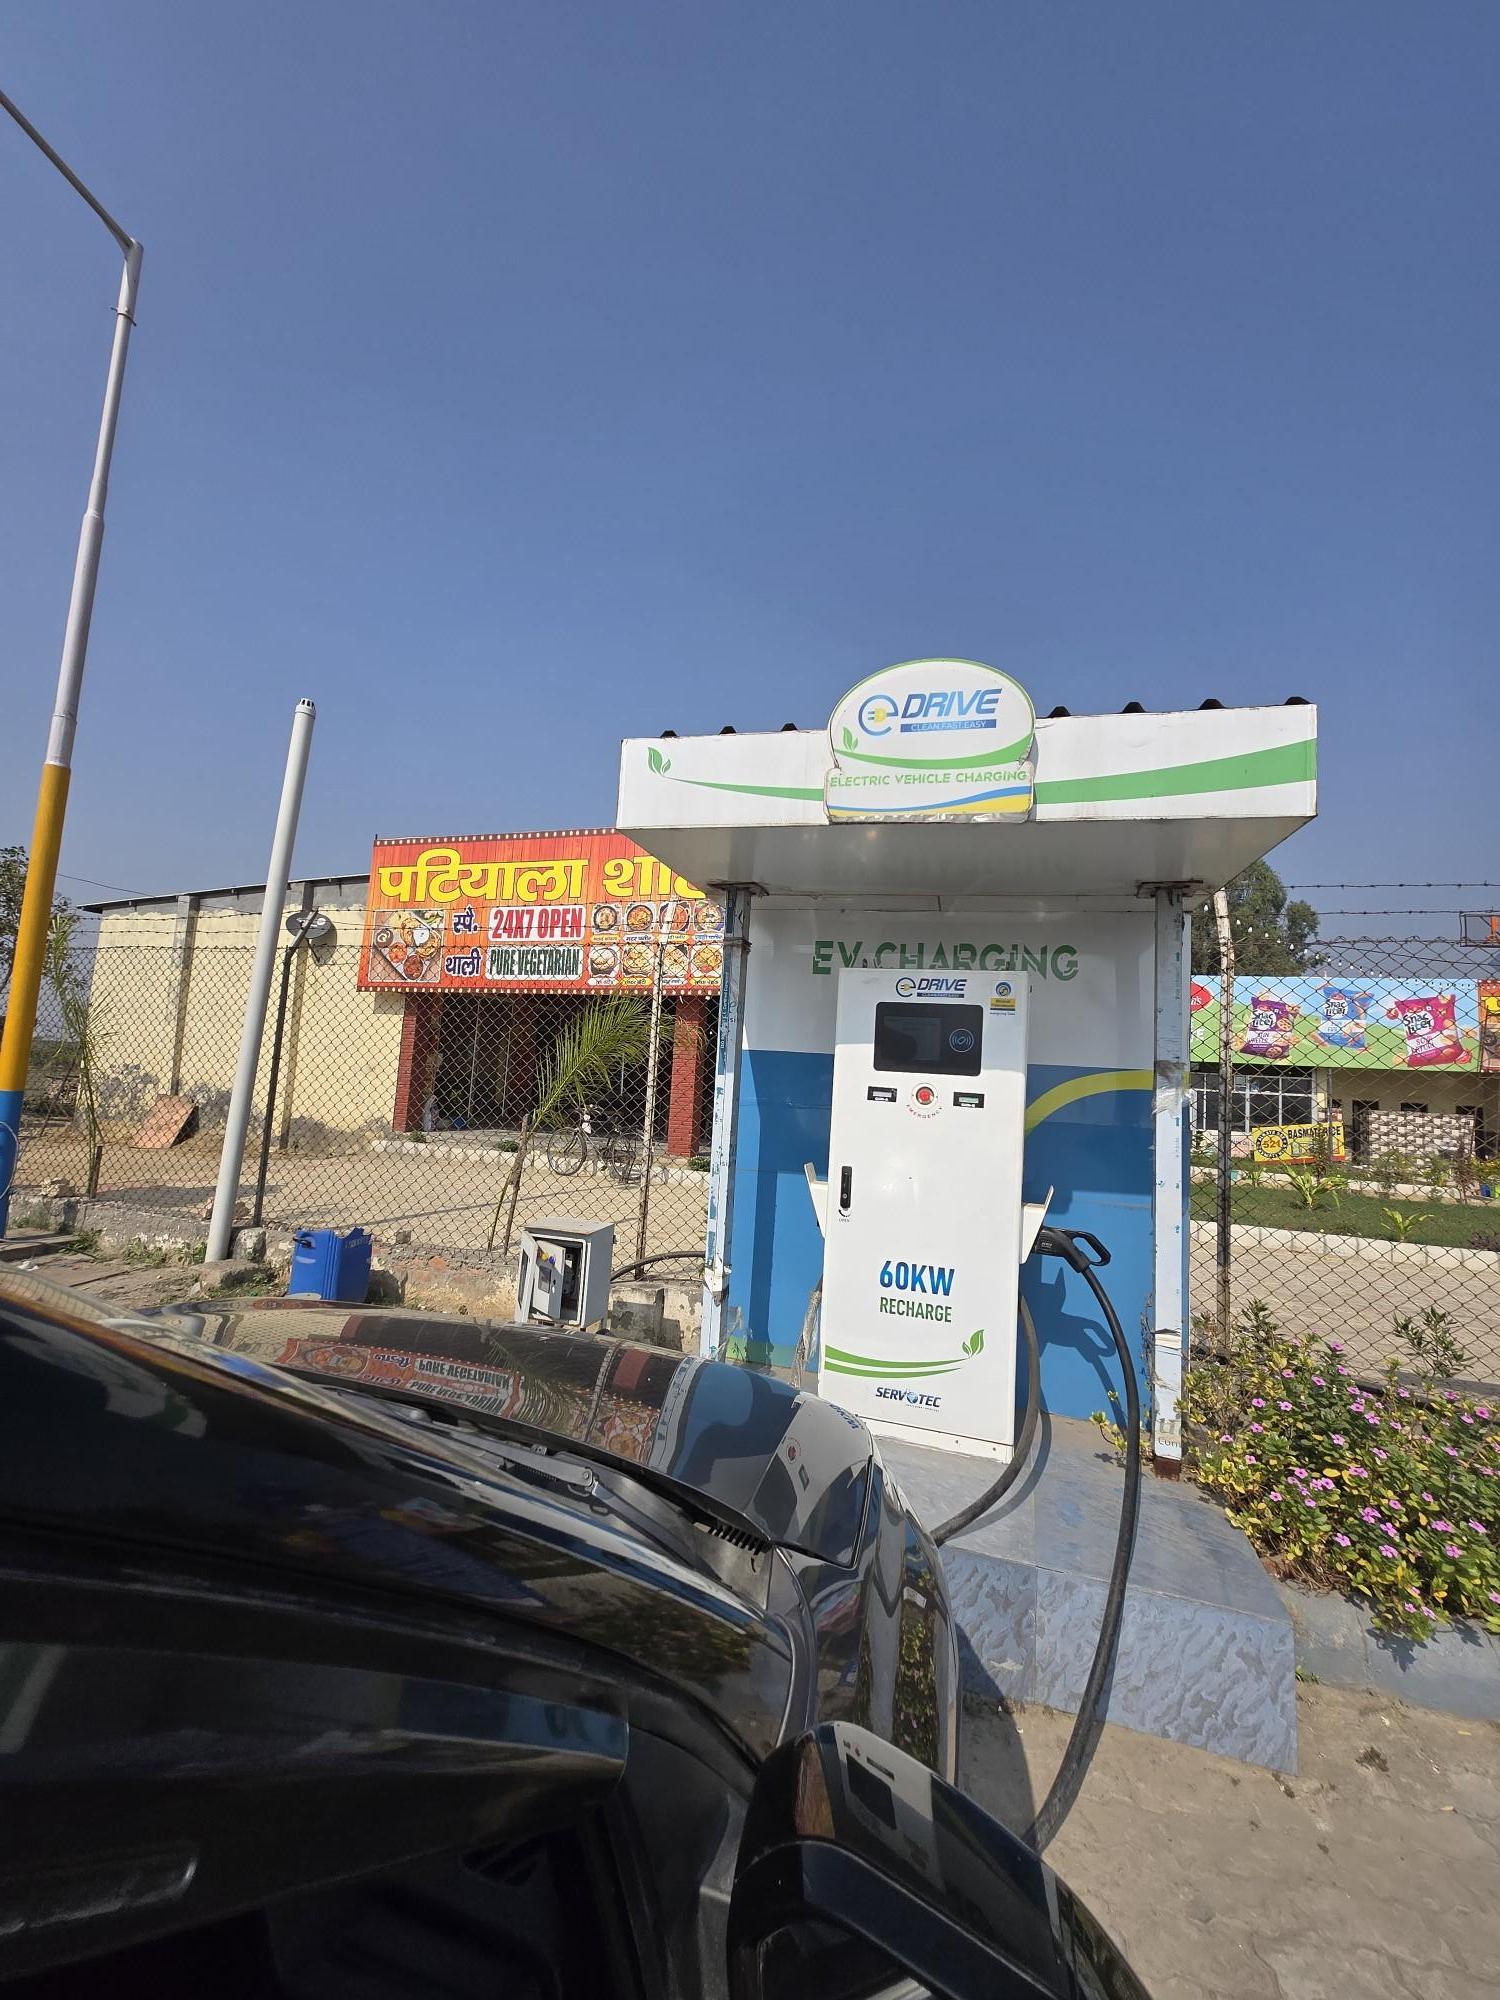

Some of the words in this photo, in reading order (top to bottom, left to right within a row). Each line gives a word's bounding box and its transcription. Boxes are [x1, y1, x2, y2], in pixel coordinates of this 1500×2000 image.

[829, 775, 890, 787] ELECTRIC
[895, 773, 950, 785] VEHICLE
[955, 770, 1027, 782] CHARGING
[378, 848, 589, 903] पटियाला
[492, 909, 535, 939] 24X7
[537, 907, 583, 939] OPEN
[445, 948, 481, 975] थाली
[489, 949, 517, 975] PURE
[518, 948, 580, 975] VEGETARIAN
[812, 940, 863, 974] EV
[879, 1260, 955, 1296] 60KW
[879, 1296, 953, 1323] RECHARGE
